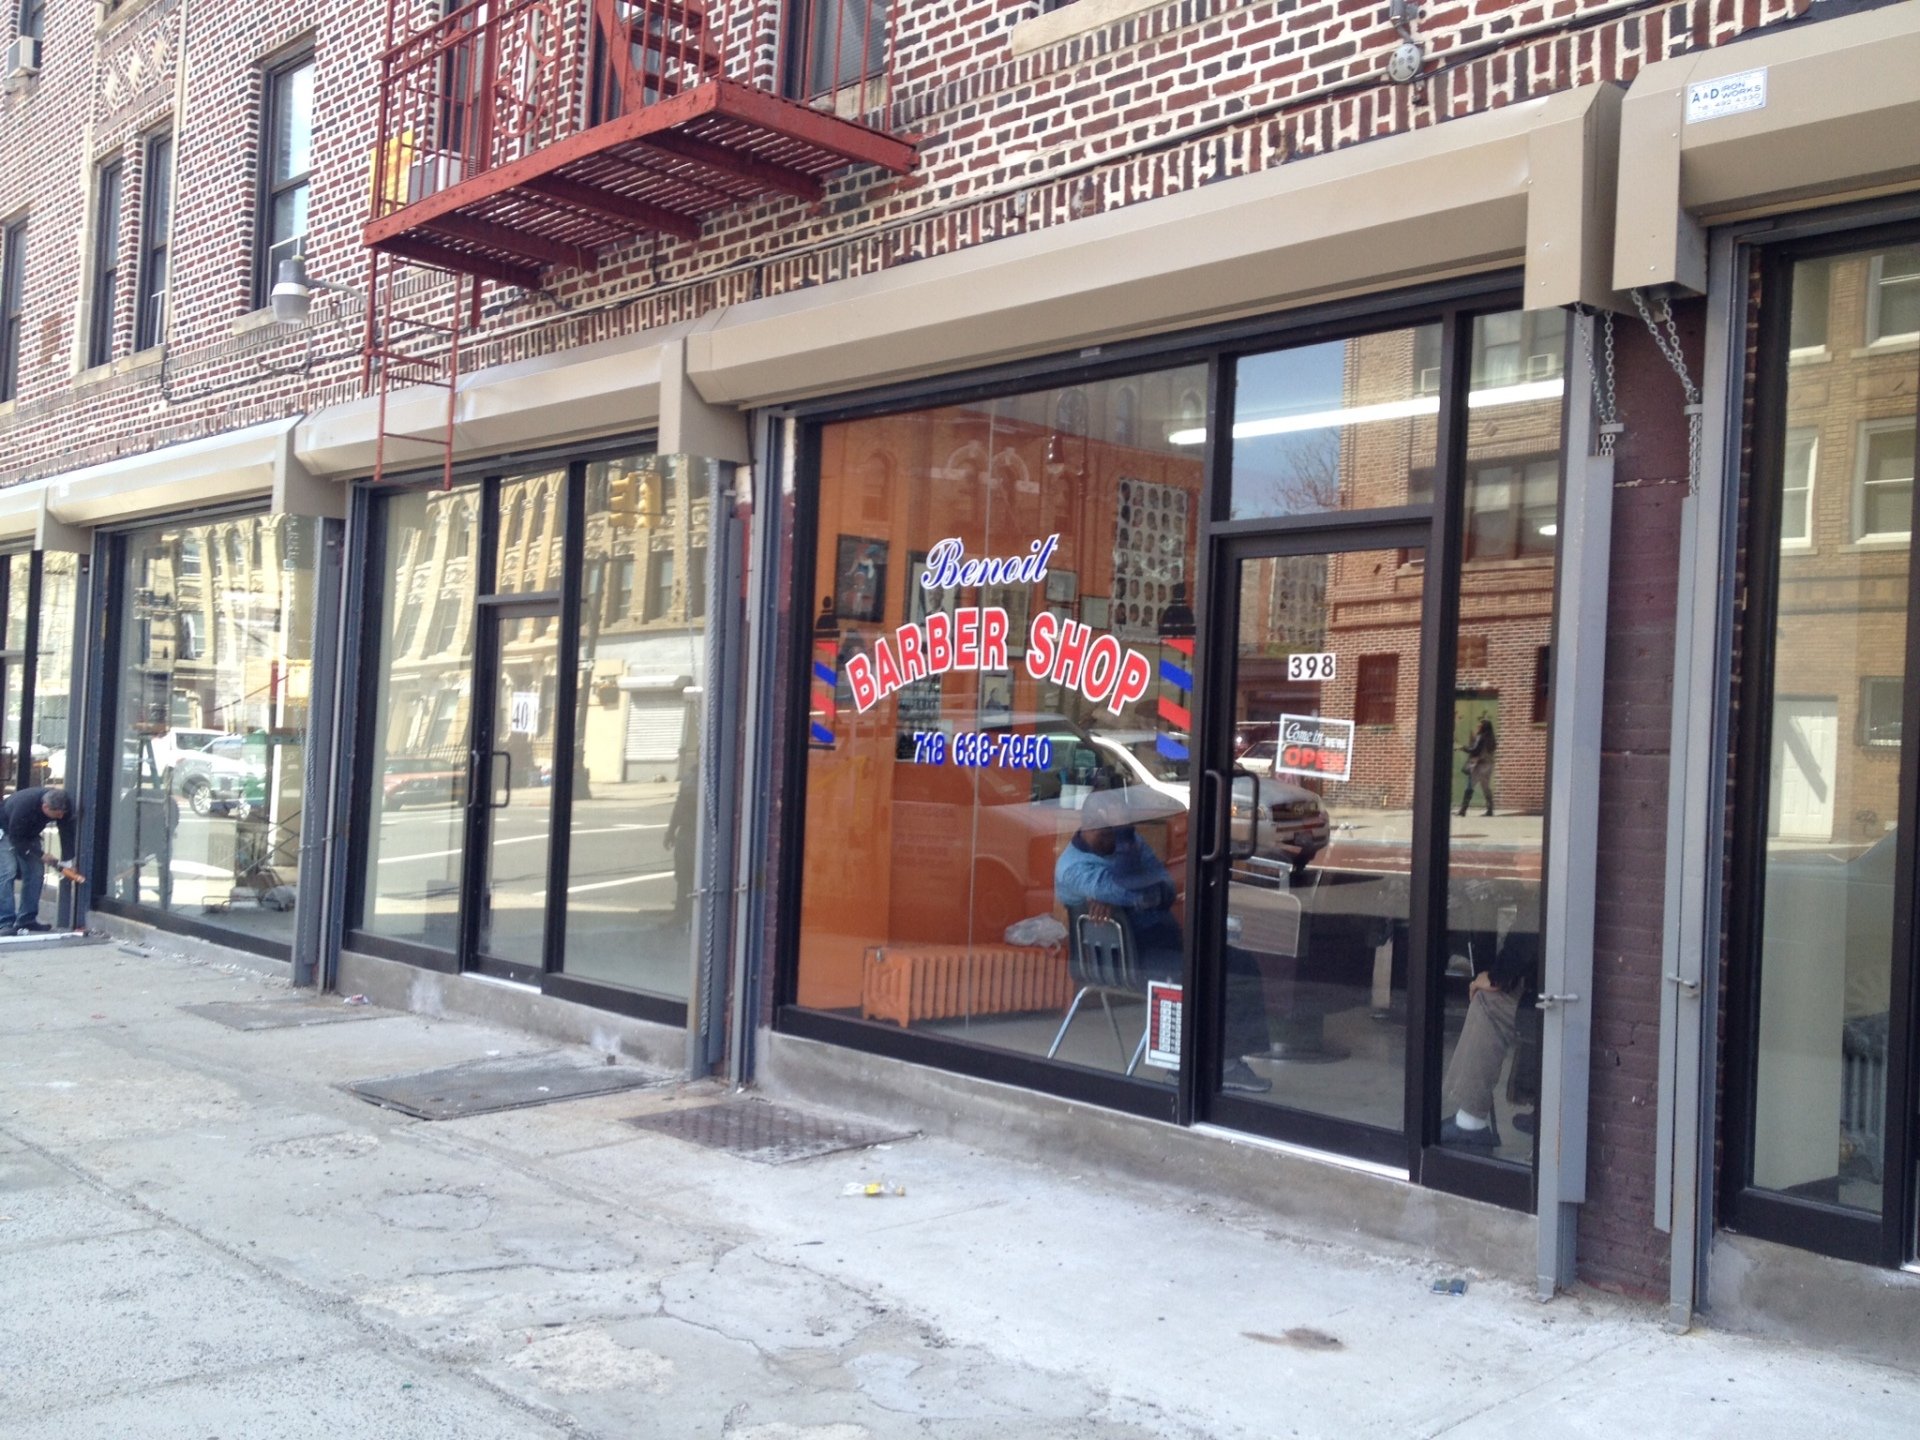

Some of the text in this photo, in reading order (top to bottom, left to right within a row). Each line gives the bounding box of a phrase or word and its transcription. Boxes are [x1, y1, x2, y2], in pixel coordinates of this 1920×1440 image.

[1722, 84, 1762, 99] WORKS
[921, 533, 1060, 590] Benoit
[845, 607, 1151, 716] BARBER SHOP
[1291, 655, 1333, 678] 398
[1286, 722, 1312, 742] Come
[913, 731, 1052, 770] 718 638-7950
